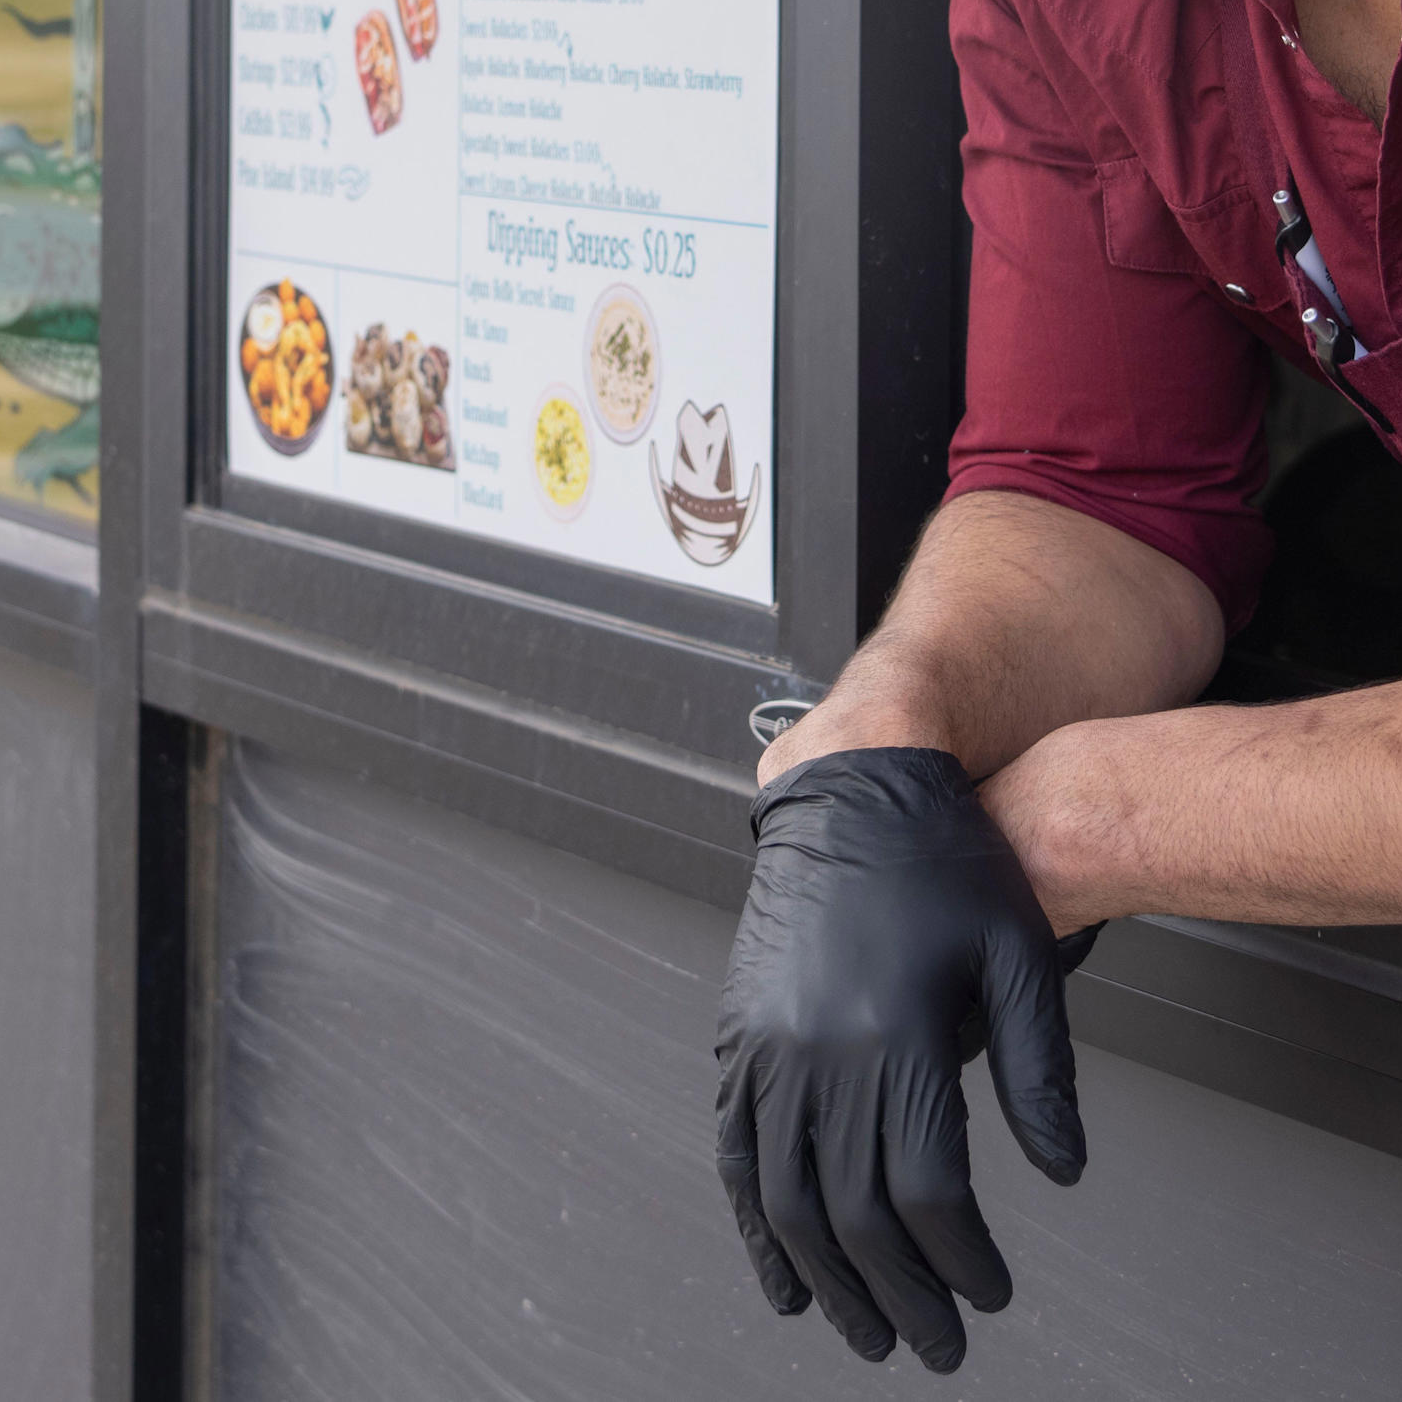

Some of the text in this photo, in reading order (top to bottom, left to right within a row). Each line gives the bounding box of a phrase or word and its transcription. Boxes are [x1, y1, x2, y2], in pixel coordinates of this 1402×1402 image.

[683, 65, 744, 100] Strawberry
[487, 209, 559, 274] Dipping
[642, 226, 697, 279] $0.25
